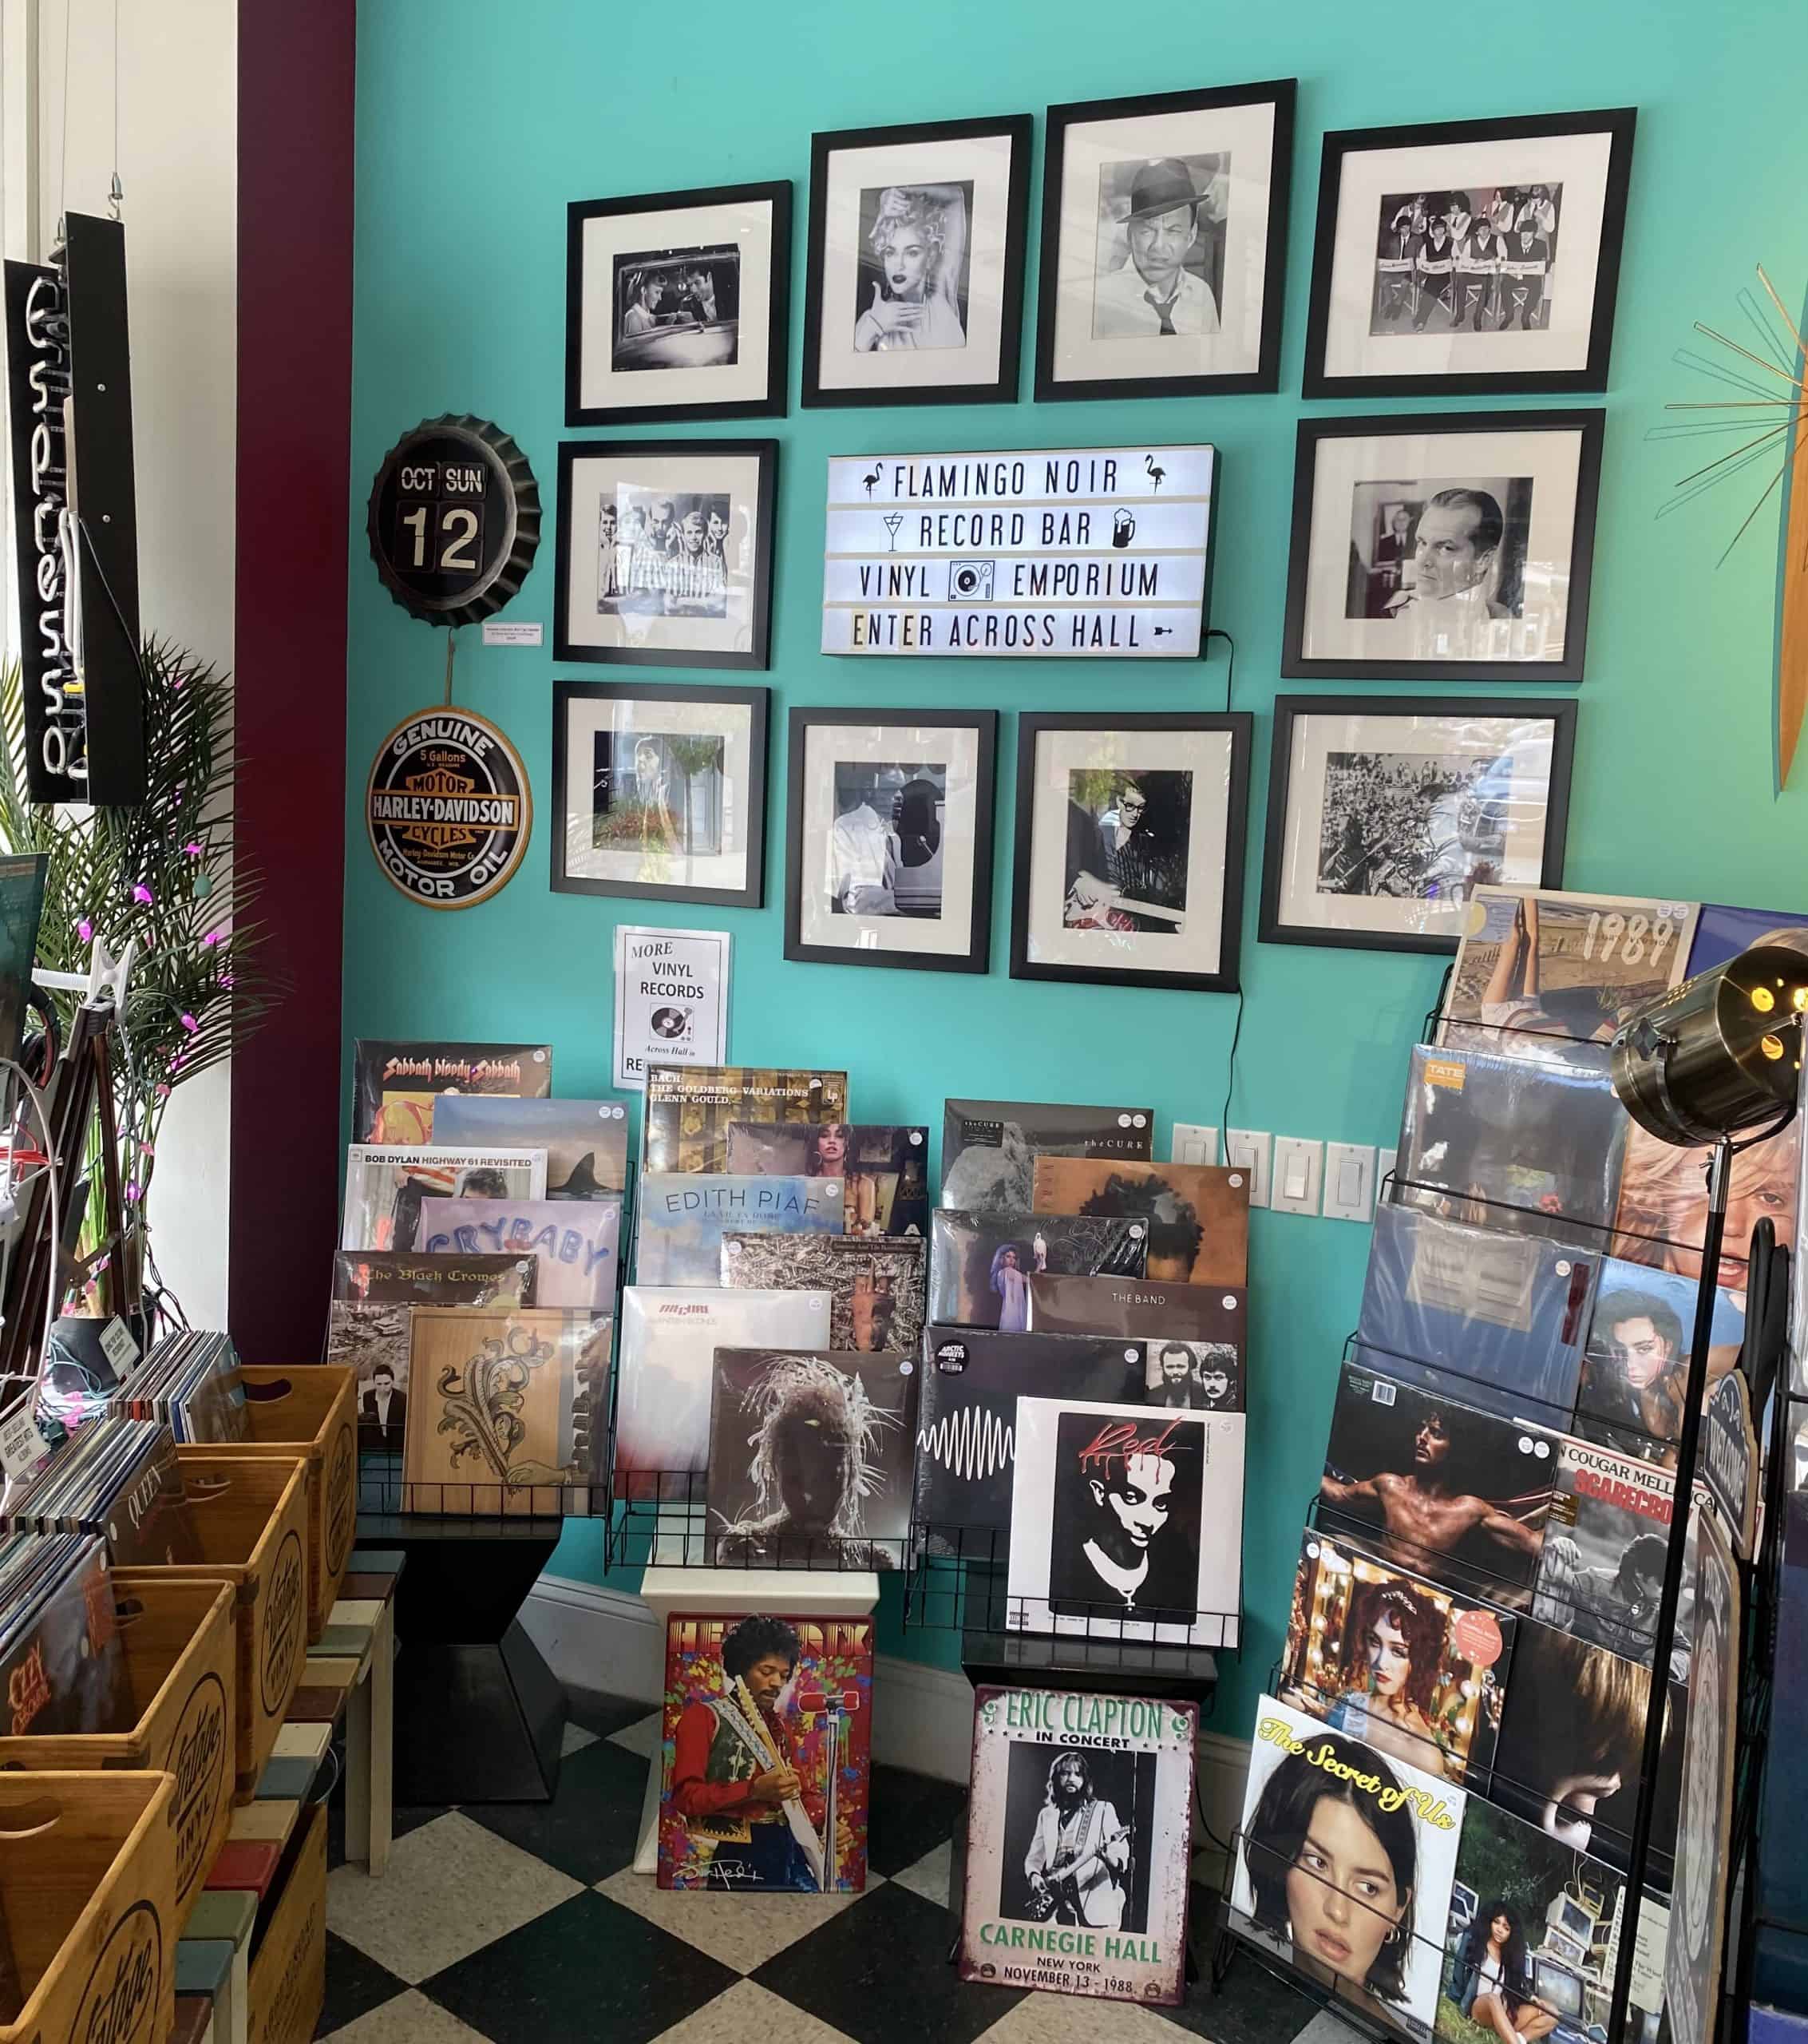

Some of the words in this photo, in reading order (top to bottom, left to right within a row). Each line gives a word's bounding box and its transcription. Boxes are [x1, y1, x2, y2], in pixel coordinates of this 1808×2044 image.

[402, 467, 436, 490] OCT
[445, 468, 482, 493] SUN
[894, 461, 1025, 498] FLAMINGO
[1045, 458, 1118, 493] NOIR
[403, 506, 479, 569] 12
[920, 513, 1025, 548] RECORD
[1042, 512, 1091, 545] BAR
[860, 564, 931, 597] VINYL
[1014, 563, 1158, 596] EMPORIUM
[853, 614, 932, 647] ENTER
[949, 615, 1056, 648] ACROSS
[1072, 615, 1139, 648] HALL
[393, 719, 495, 758] GENUINE
[420, 750, 427, 762] 5
[429, 750, 466, 764] Gallons
[413, 772, 469, 794] MOTOR
[373, 796, 513, 825] HARLEY-DAVIDSON
[411, 826, 467, 846] CYCLES
[378, 838, 456, 898] MOTOR
[469, 849, 508, 885] OIL
[631, 941, 674, 959] MORE
[1584, 911, 1673, 968] 1989
[652, 961, 694, 978] VINYL
[640, 981, 705, 999] RECORDS
[645, 1044, 670, 1055] Across
[671, 1046, 688, 1056] Hall
[382, 1056, 433, 1083] Sabbath
[469, 1057, 520, 1083] Sabbath
[1430, 1064, 1464, 1078] TATE
[649, 1094, 688, 1103] GLENN
[650, 1083, 674, 1094] THE
[677, 1084, 738, 1095] GOLDBERG
[742, 1087, 809, 1098] VARIATIONS
[364, 1155, 386, 1164] BOB
[387, 1155, 420, 1165] DYLAN
[421, 1157, 467, 1166] HIGHWAY
[480, 1158, 532, 1167] REVISITED
[666, 1188, 746, 1213] EDITH
[758, 1190, 820, 1214] PIAF
[398, 1268, 442, 1281] Black
[447, 1270, 506, 1282] Crowes
[1111, 1293, 1132, 1304] THE
[1133, 1293, 1166, 1305] BAND
[1568, 1448, 1631, 1480] COUGAR
[128, 1465, 162, 1530] QUEEN
[1573, 1468, 1692, 1527] SCARECRO
[1007, 1689, 1058, 1730] ERIC
[1062, 1694, 1165, 1739] CLAPTON
[1035, 1731, 1053, 1743] IN
[1059, 1733, 1130, 1749] CONCERT
[1257, 1717, 1306, 1756] The
[1306, 1744, 1382, 1794] Secret
[1378, 1785, 1418, 1812] of
[1415, 1792, 1456, 1830] Us
[979, 1923, 1096, 1956] CARNEGIE
[1104, 1938, 1162, 1964] HALL
[1003, 1966, 1070, 1987] NOVEMBER
[1075, 1974, 1090, 1989] 13
[1036, 1956, 1066, 1969] NEW
[1068, 1959, 1101, 1974] YORK
